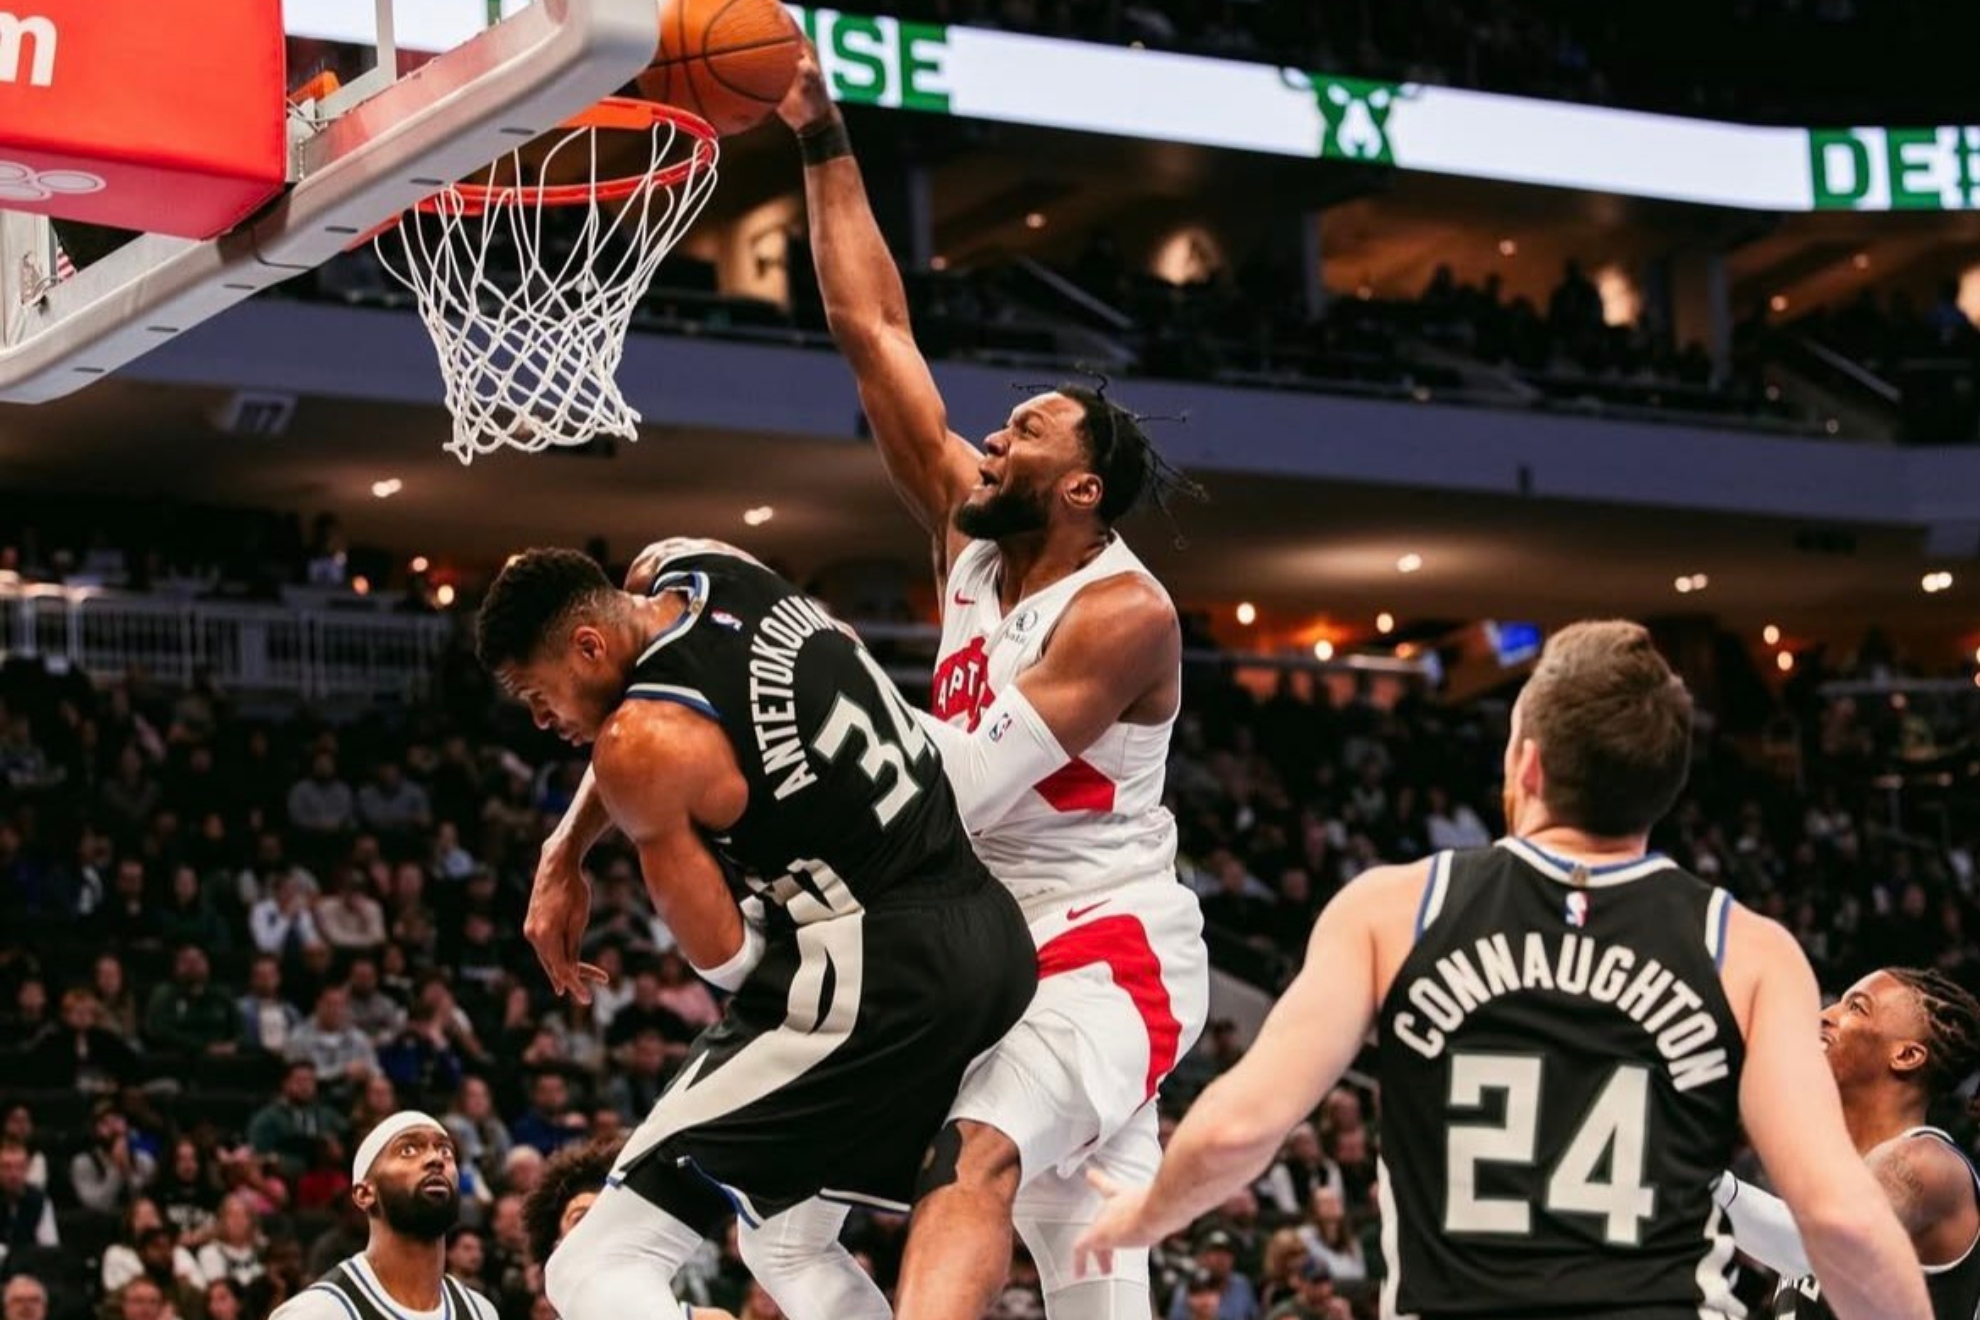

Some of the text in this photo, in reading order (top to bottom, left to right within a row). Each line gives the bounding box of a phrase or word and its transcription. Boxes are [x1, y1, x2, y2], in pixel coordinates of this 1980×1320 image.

[0, 11, 57, 87] m
[805, 8, 949, 112] SE
[811, 646, 937, 828] 34
[1393, 932, 1729, 1092] CONNAUGHTON
[1445, 1054, 1654, 1244] 24
